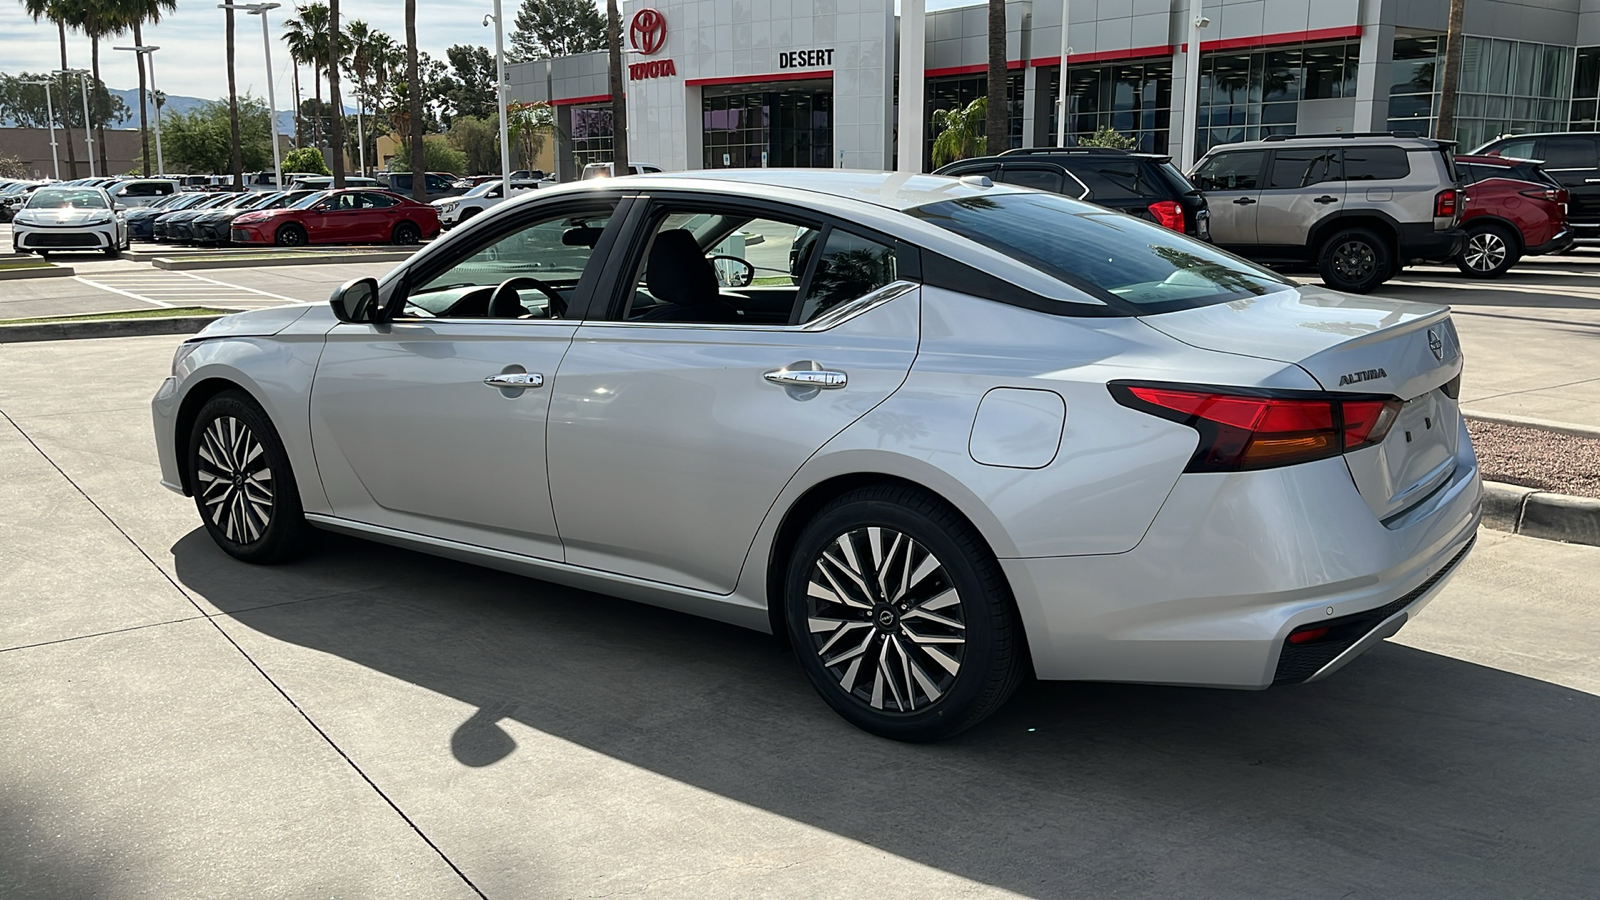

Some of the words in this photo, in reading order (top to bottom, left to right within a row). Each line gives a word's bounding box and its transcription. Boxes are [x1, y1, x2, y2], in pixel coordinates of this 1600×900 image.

[779, 48, 834, 69] DESERT
[628, 59, 676, 81] TOYOTA
[1339, 367, 1387, 387] ALTIMA
